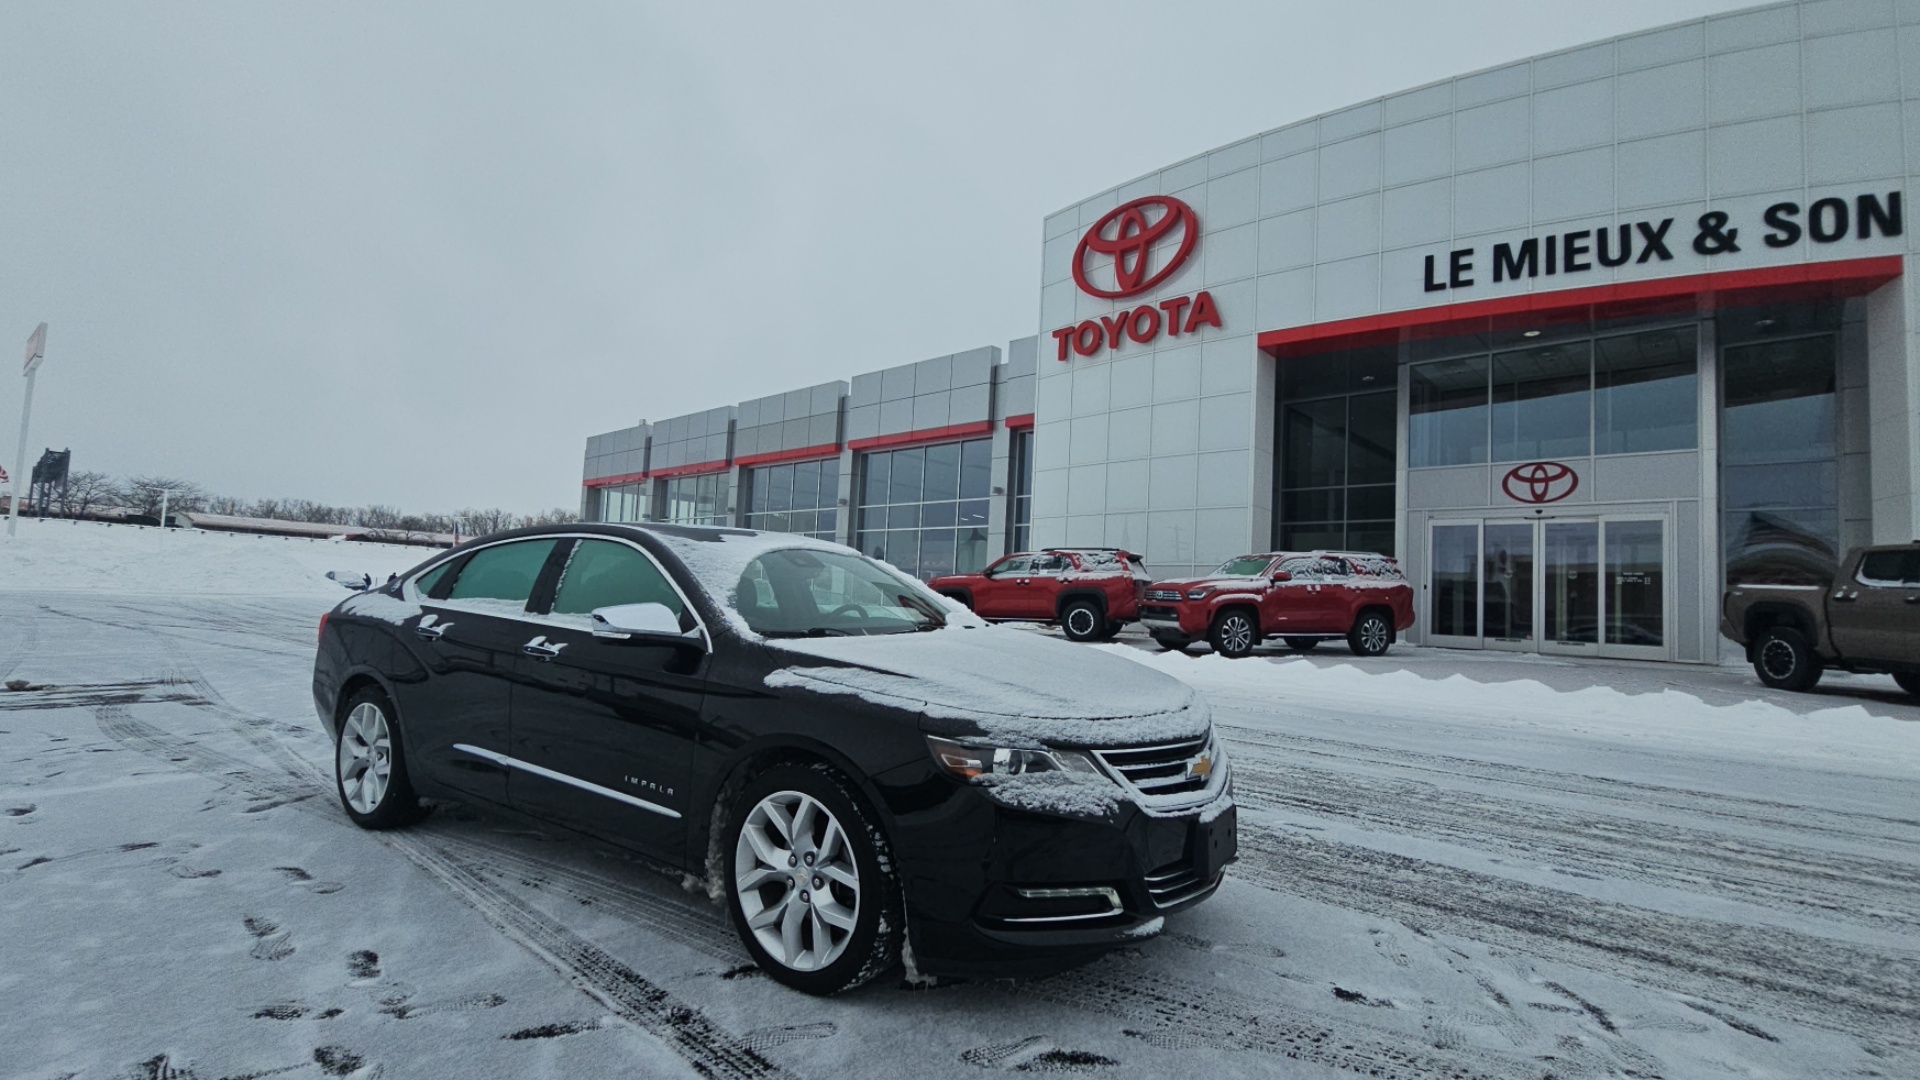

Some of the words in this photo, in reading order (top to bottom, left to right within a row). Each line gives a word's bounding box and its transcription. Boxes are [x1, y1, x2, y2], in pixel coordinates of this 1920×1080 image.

[1424, 248, 1474, 292] LE
[1492, 218, 1674, 283] MIEUX
[1693, 211, 1740, 255] &
[1764, 191, 1903, 248] SON
[1052, 290, 1223, 362] TOYOTA
[624, 774, 674, 796] IMPALA
